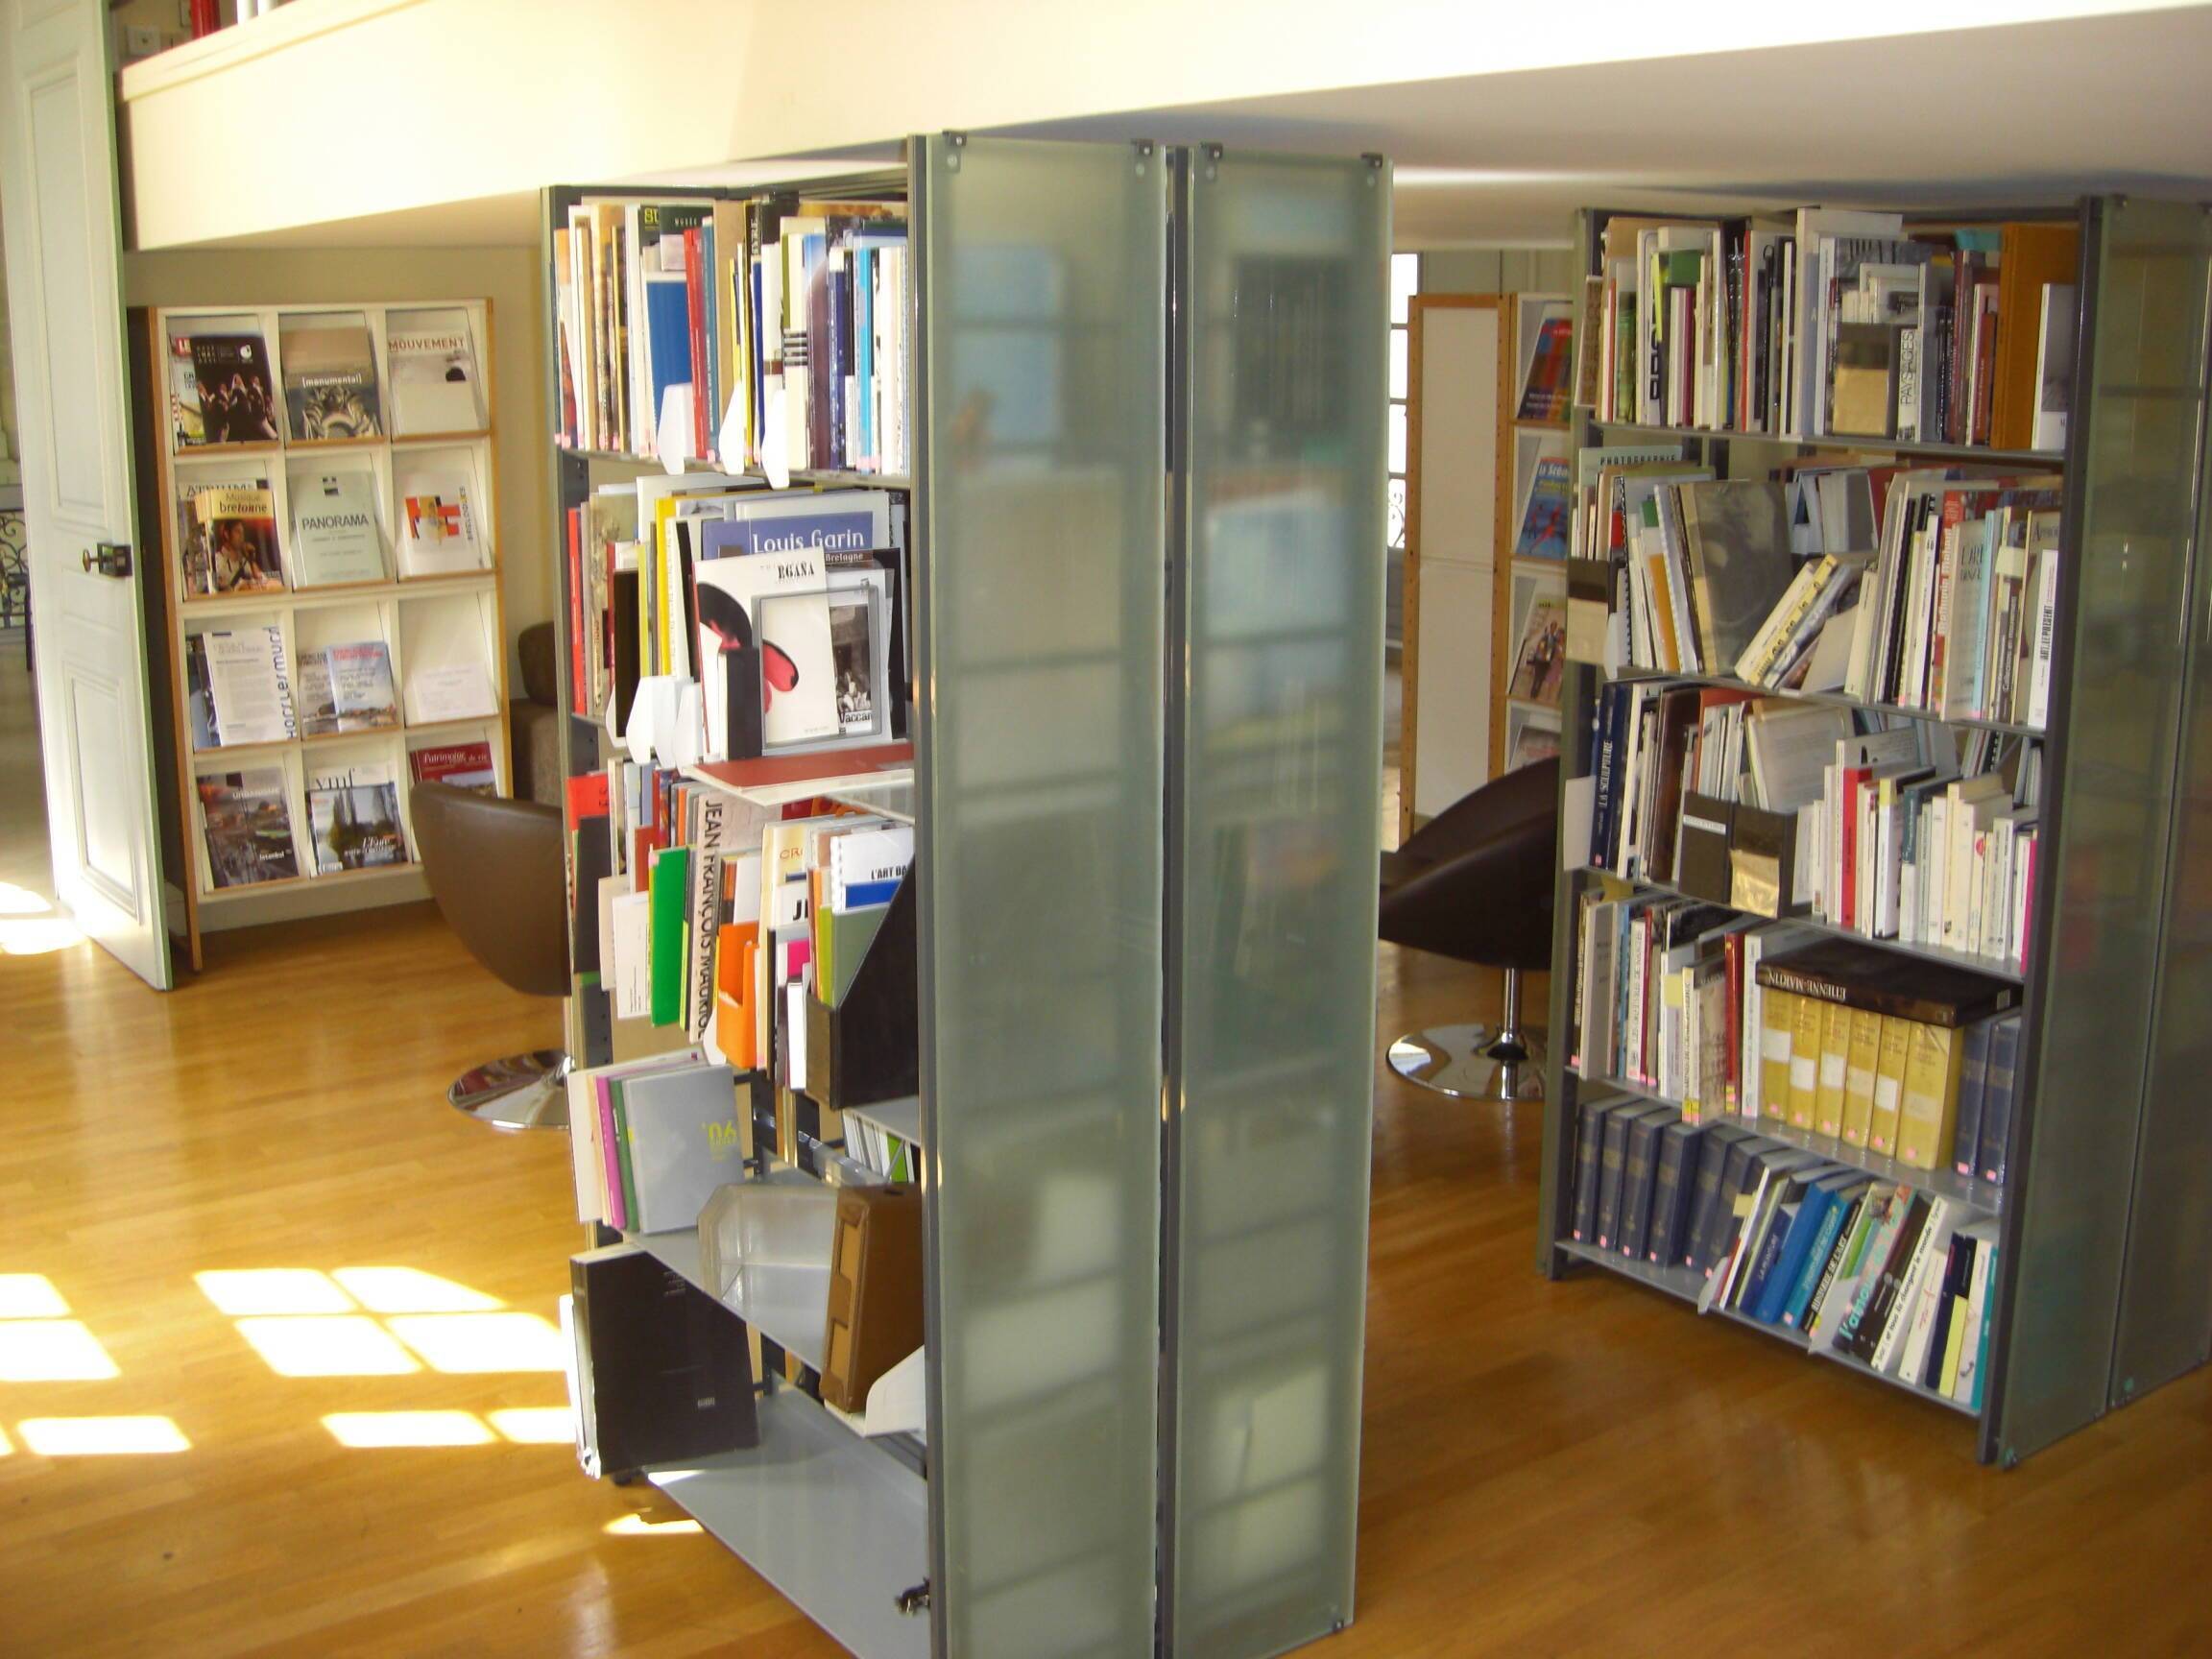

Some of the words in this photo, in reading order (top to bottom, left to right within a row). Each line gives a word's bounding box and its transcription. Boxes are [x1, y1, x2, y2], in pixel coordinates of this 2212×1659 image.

[388, 337, 464, 352] MOUVEMENT
[301, 514, 370, 531] PANORAMA
[752, 531, 805, 554] Louis
[811, 528, 865, 550] Garin
[703, 800, 723, 849] JEAN
[871, 866, 894, 880] L'ART
